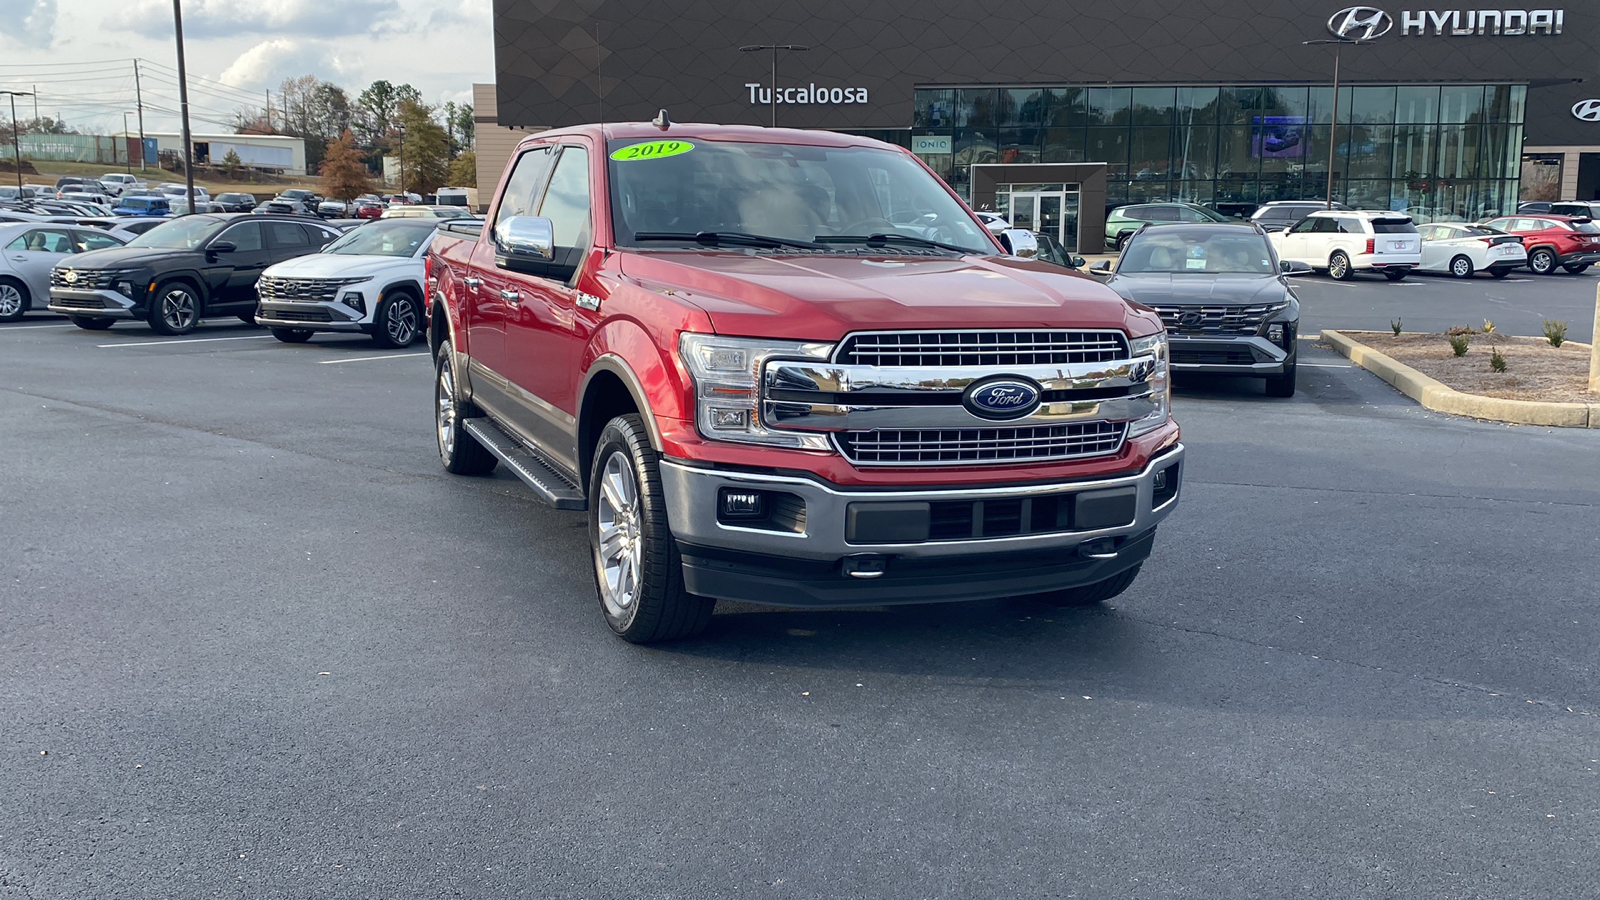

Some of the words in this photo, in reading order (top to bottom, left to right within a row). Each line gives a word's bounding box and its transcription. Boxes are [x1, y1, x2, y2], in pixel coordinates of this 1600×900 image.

[1401, 10, 1564, 36] HYUNDAI
[744, 82, 868, 104] Tuscaloosa
[627, 141, 680, 159] 2019
[916, 140, 947, 149] IONIQ
[987, 387, 1024, 406] Ford
